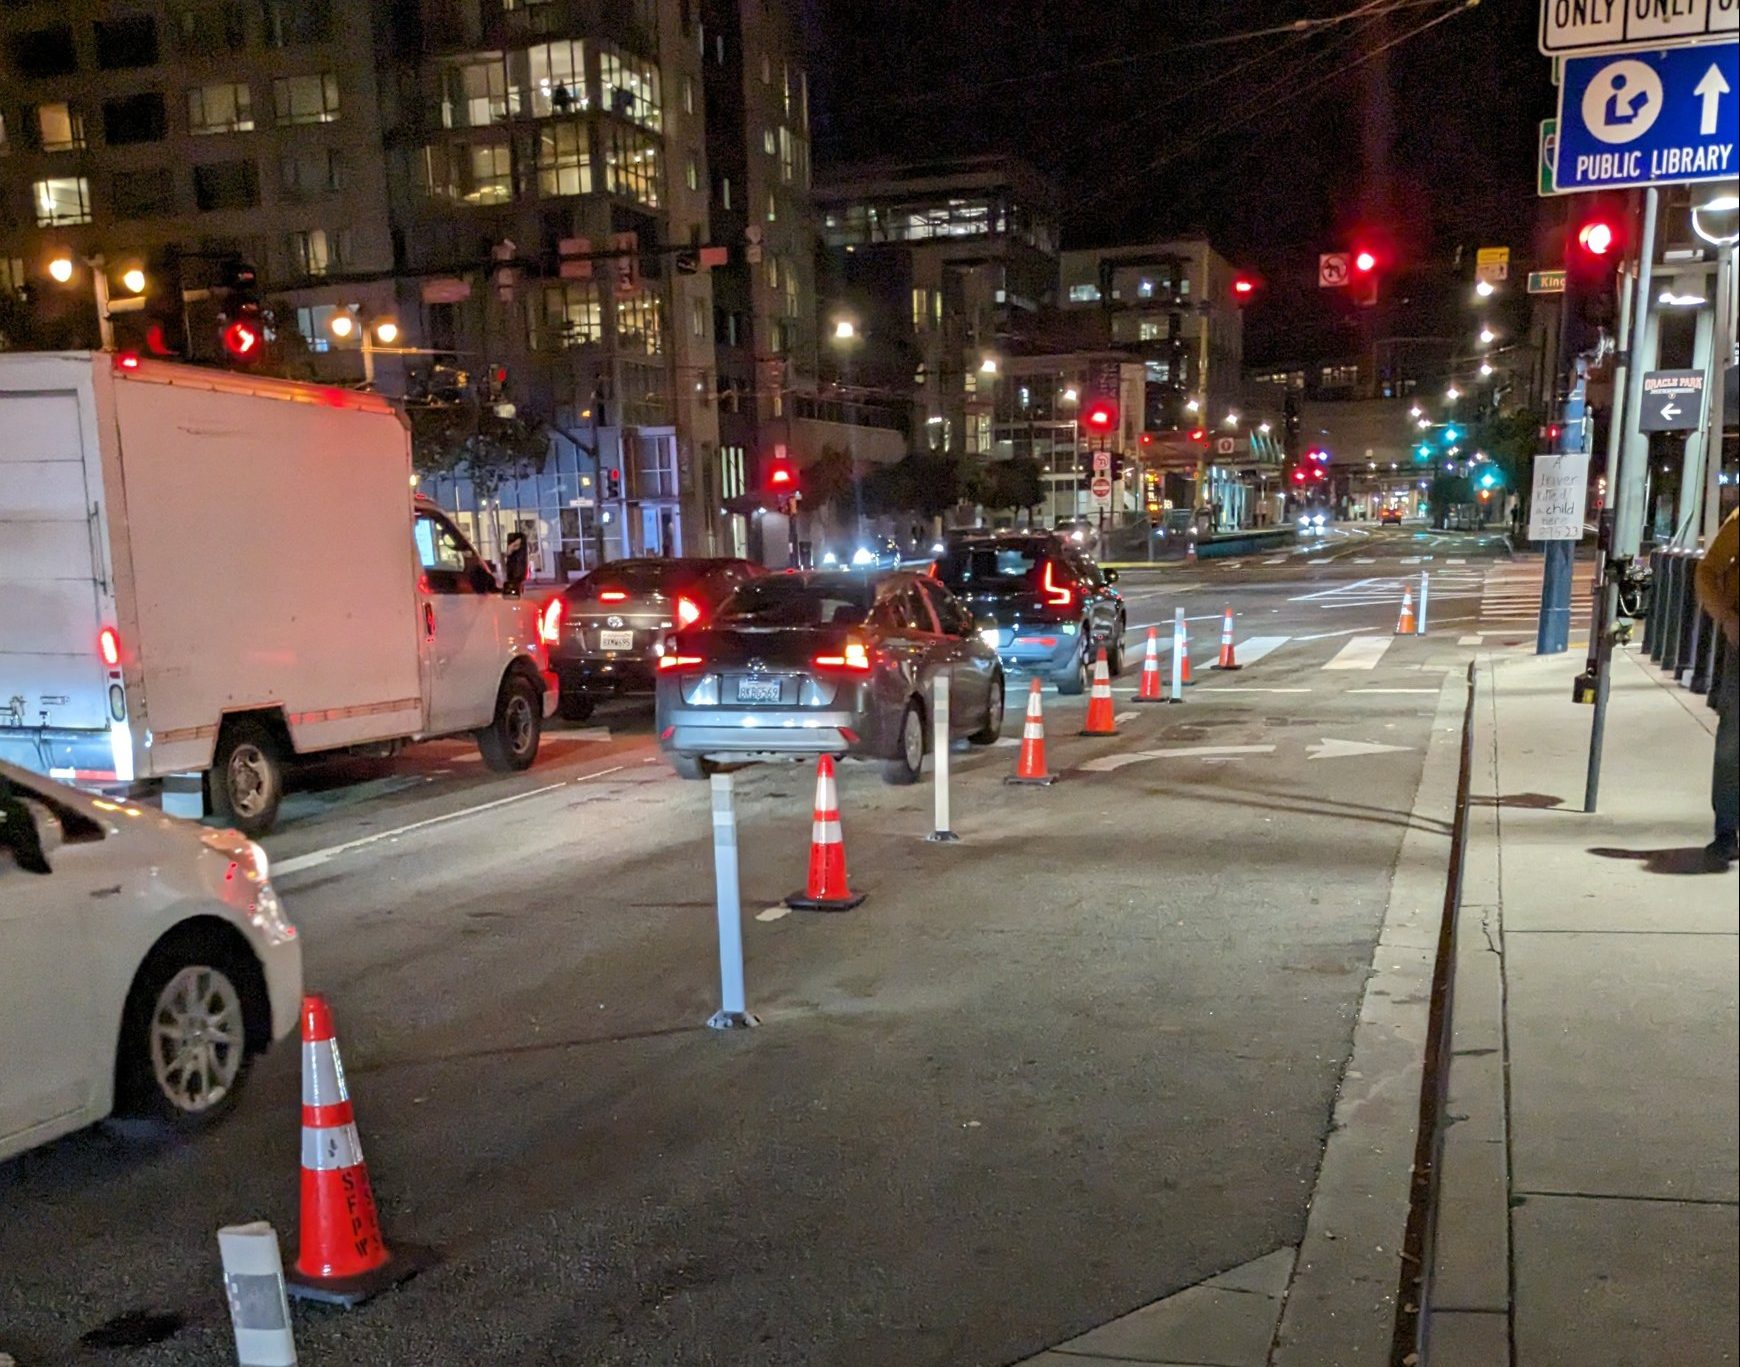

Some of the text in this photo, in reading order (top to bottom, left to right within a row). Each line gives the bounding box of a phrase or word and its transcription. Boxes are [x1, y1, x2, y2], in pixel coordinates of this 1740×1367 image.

[1555, 0, 1614, 29] ONLY
[1576, 144, 1733, 182] PUBLIC LIBRARY
[1644, 378, 1678, 392] ORACLE
[1680, 376, 1703, 390] PARK
[1545, 501, 1575, 515] child
